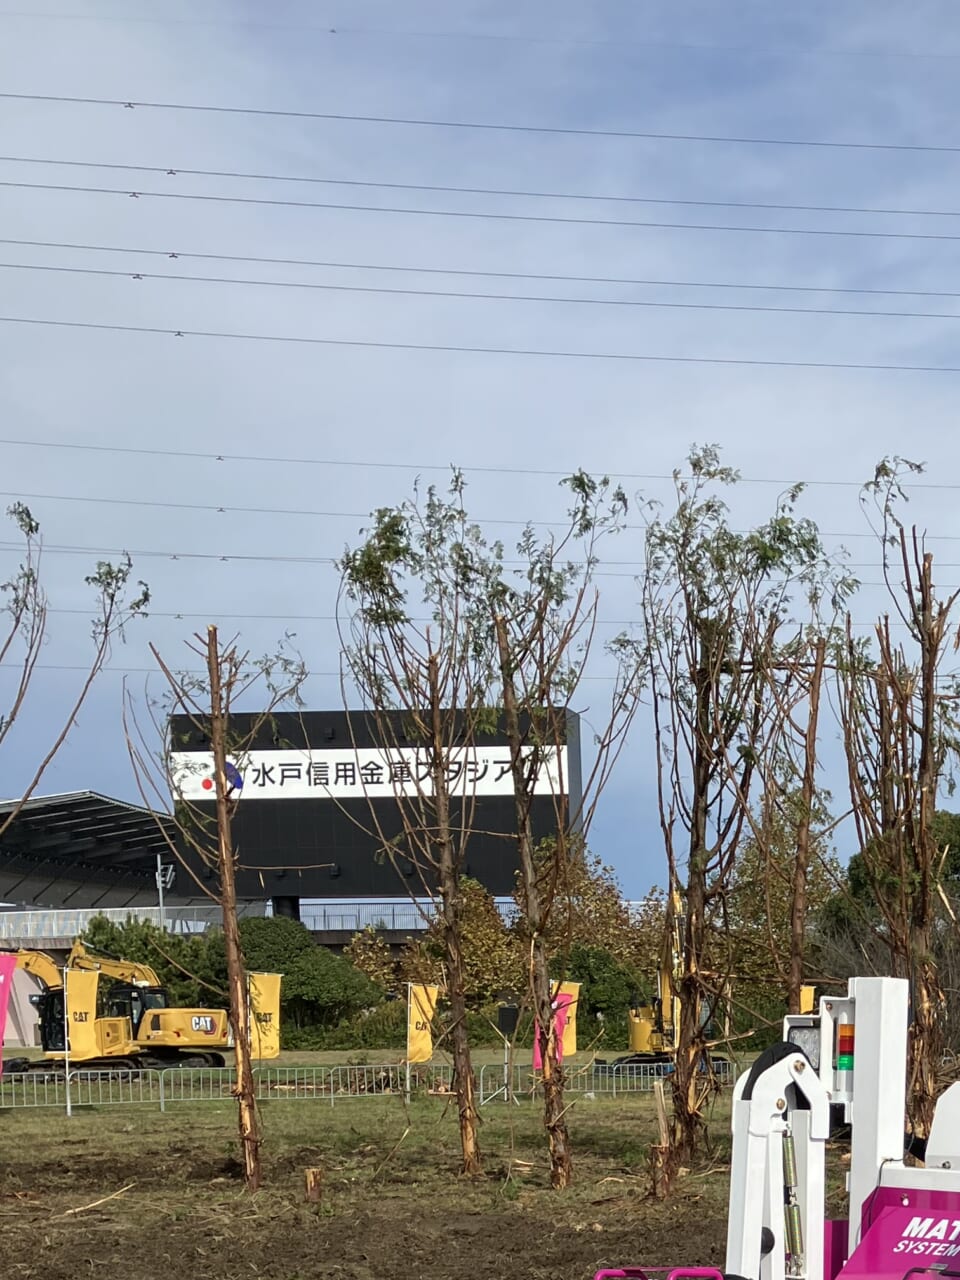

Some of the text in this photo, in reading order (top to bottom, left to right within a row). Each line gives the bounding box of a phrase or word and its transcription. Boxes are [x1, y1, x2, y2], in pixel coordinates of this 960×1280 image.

[251, 759, 539, 788] 水戸信用金庫スタジア
[73, 1011, 89, 1023] CAT
[191, 1016, 212, 1032] CAT
